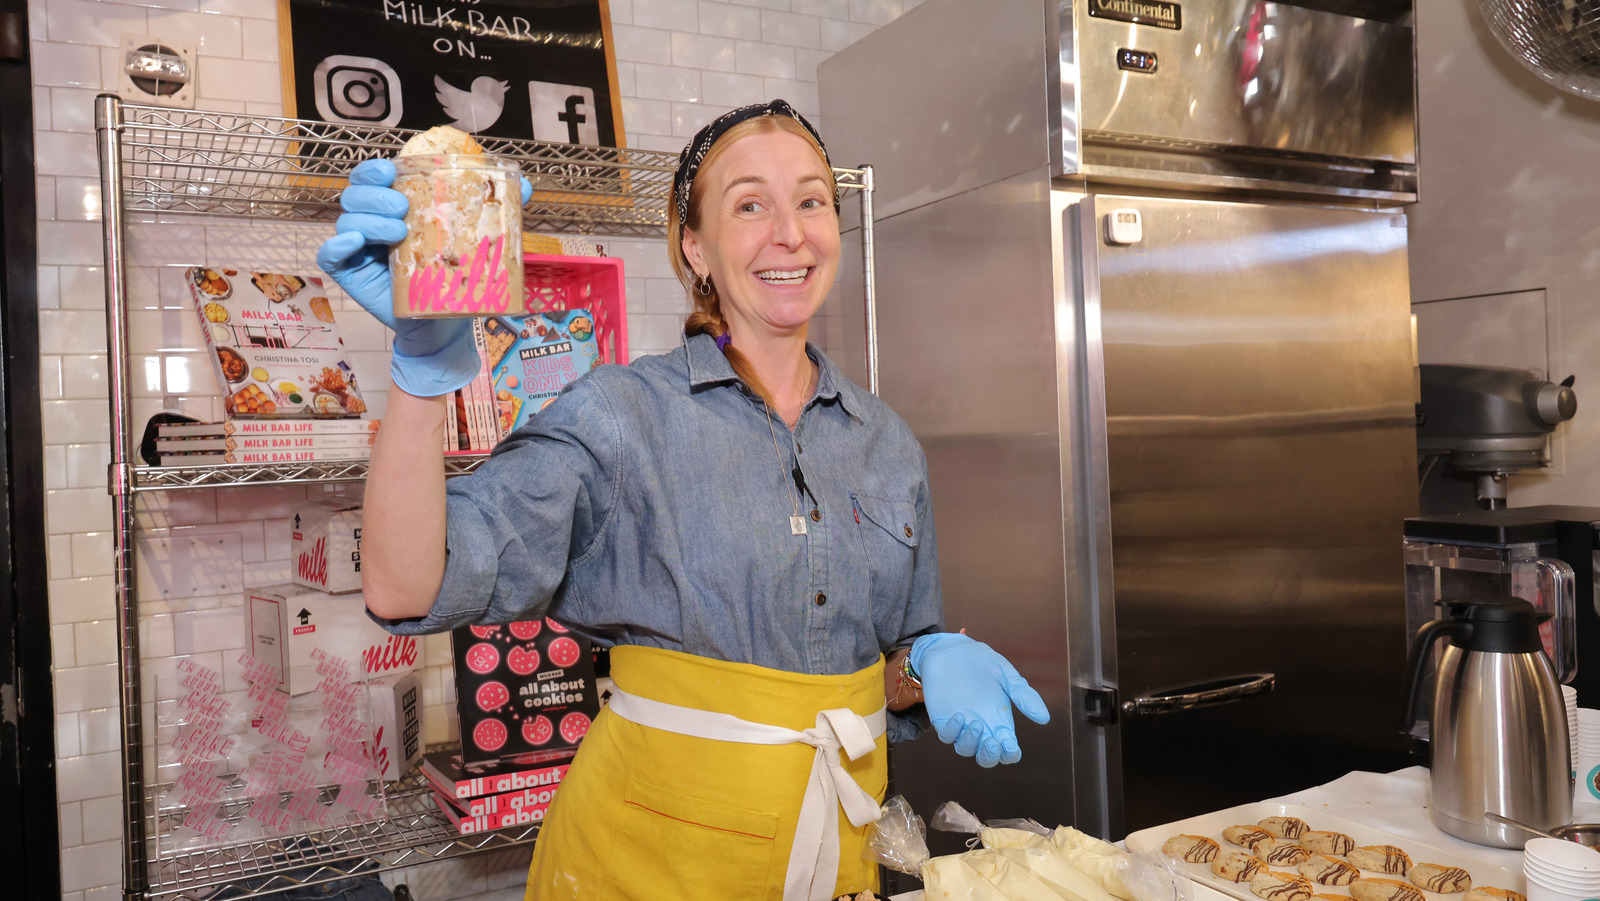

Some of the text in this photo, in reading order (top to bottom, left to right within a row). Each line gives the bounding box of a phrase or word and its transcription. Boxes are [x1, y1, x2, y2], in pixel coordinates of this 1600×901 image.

[1097, 0, 1176, 21] Continental
[468, 10, 538, 42] BAR
[408, 233, 511, 313] milk
[242, 310, 303, 322] MILK BAR
[254, 355, 299, 364] CHRISTINA
[521, 343, 571, 359] MILK BAR
[523, 355, 574, 377] KIDS
[242, 424, 268, 432] MILK
[271, 424, 291, 432] BAR
[294, 423, 313, 431] LIFE
[244, 438, 269, 448] MILK
[272, 439, 292, 447] BAR
[295, 438, 314, 447] LIFE
[243, 453, 269, 463] MILK
[272, 453, 292, 462] BAR
[295, 452, 315, 461] LIFE
[298, 536, 328, 586] milk
[362, 634, 418, 673] milk
[519, 678, 585, 696] all about
[524, 692, 584, 708] cookies
[456, 777, 484, 799] all
[497, 768, 561, 792] about
[470, 795, 498, 818] all
[510, 789, 557, 810] abo
[460, 815, 488, 835] all
[501, 808, 548, 827] abo
